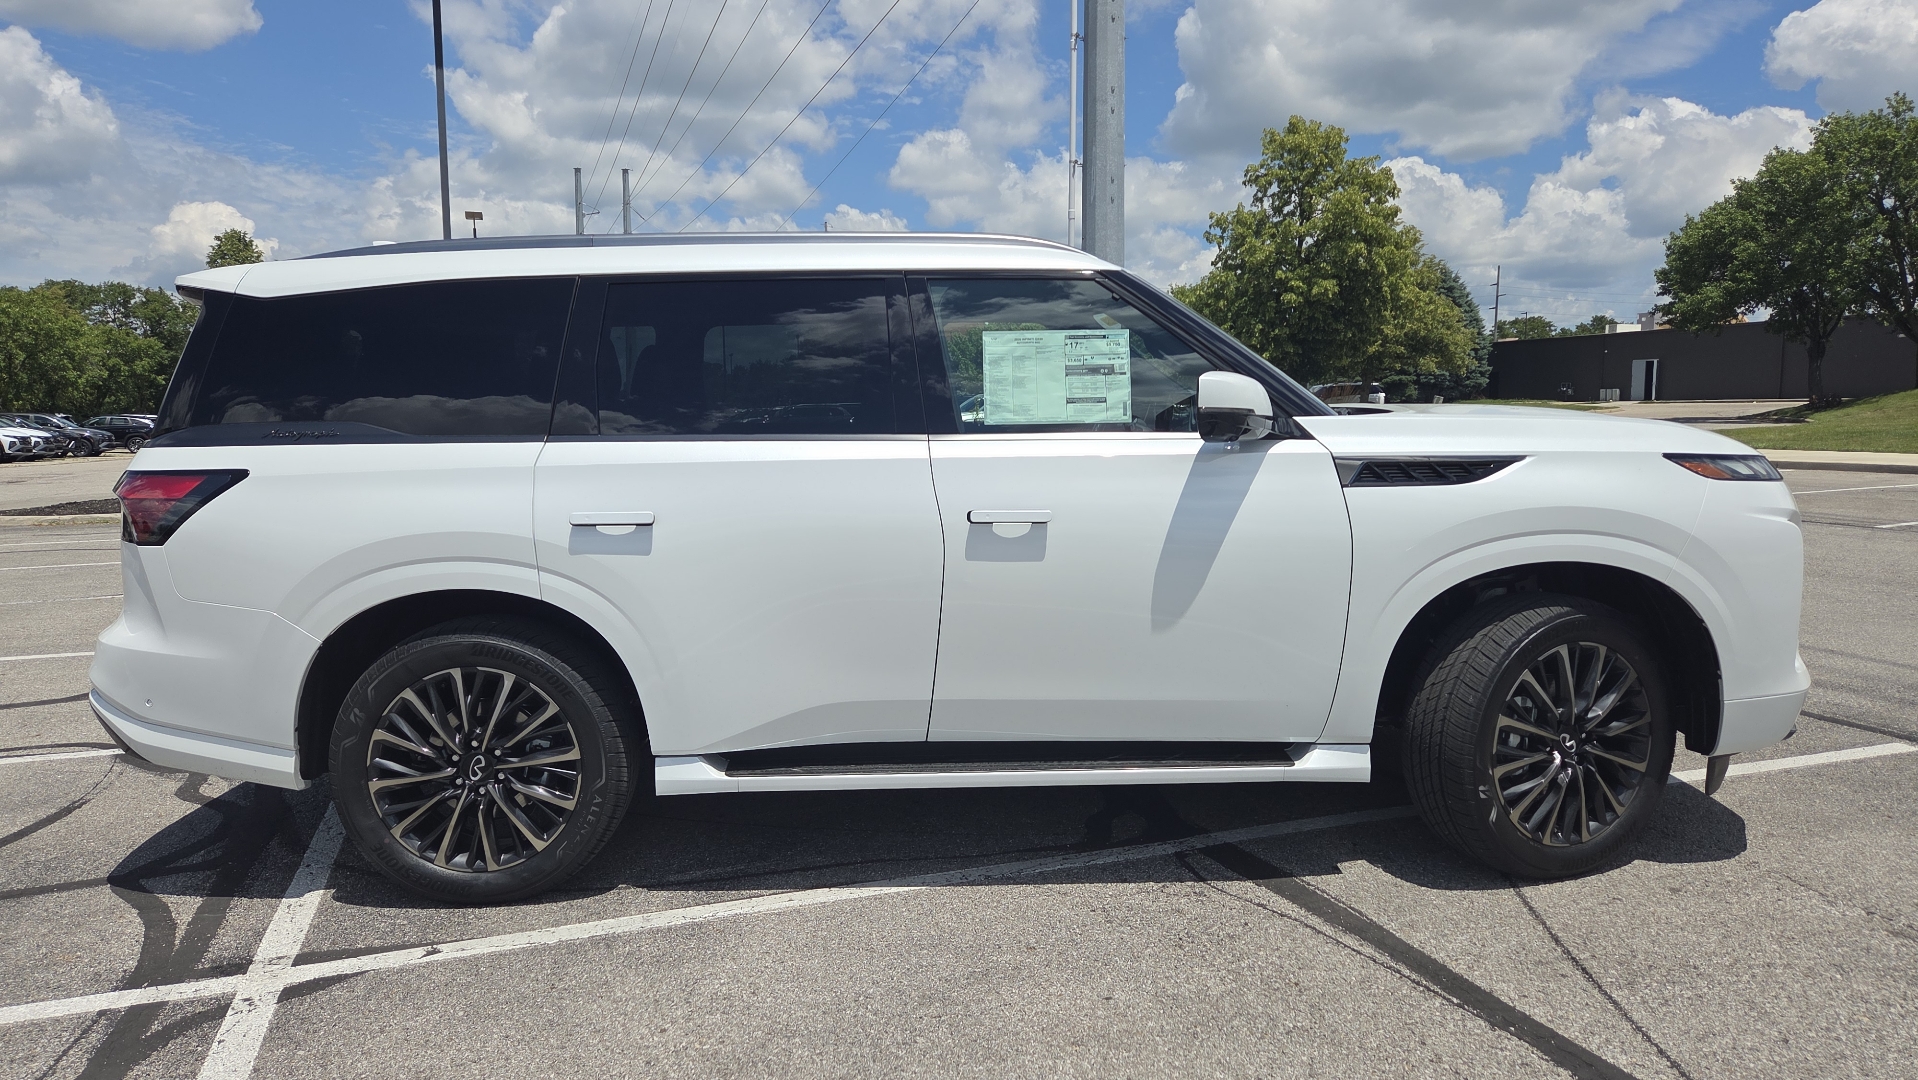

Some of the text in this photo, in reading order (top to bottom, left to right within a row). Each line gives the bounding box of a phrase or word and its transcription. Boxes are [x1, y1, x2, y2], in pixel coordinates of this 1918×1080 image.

[1069, 342, 1079, 350] 17
[470, 643, 576, 701] BRIDGESTONE
[370, 843, 474, 898] BRIDGESTONE
